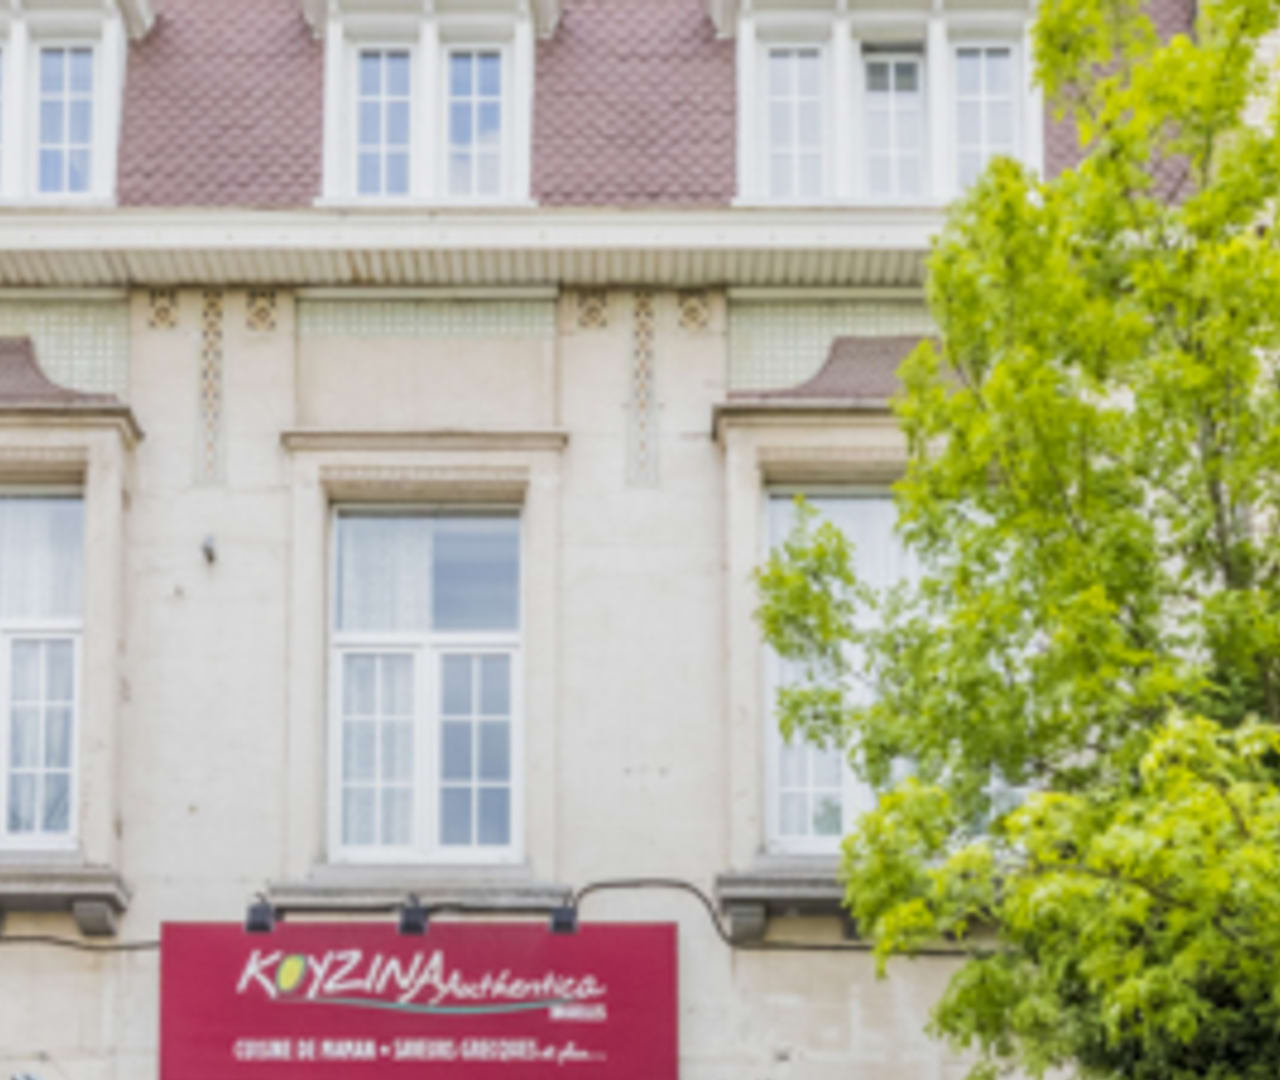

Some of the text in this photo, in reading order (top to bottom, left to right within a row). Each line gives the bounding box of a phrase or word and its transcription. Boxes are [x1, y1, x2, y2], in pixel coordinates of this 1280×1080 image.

[233, 1038, 290, 1061] CUISINE
[298, 1038, 315, 1061] DE
[322, 1038, 376, 1061] MAMAN
